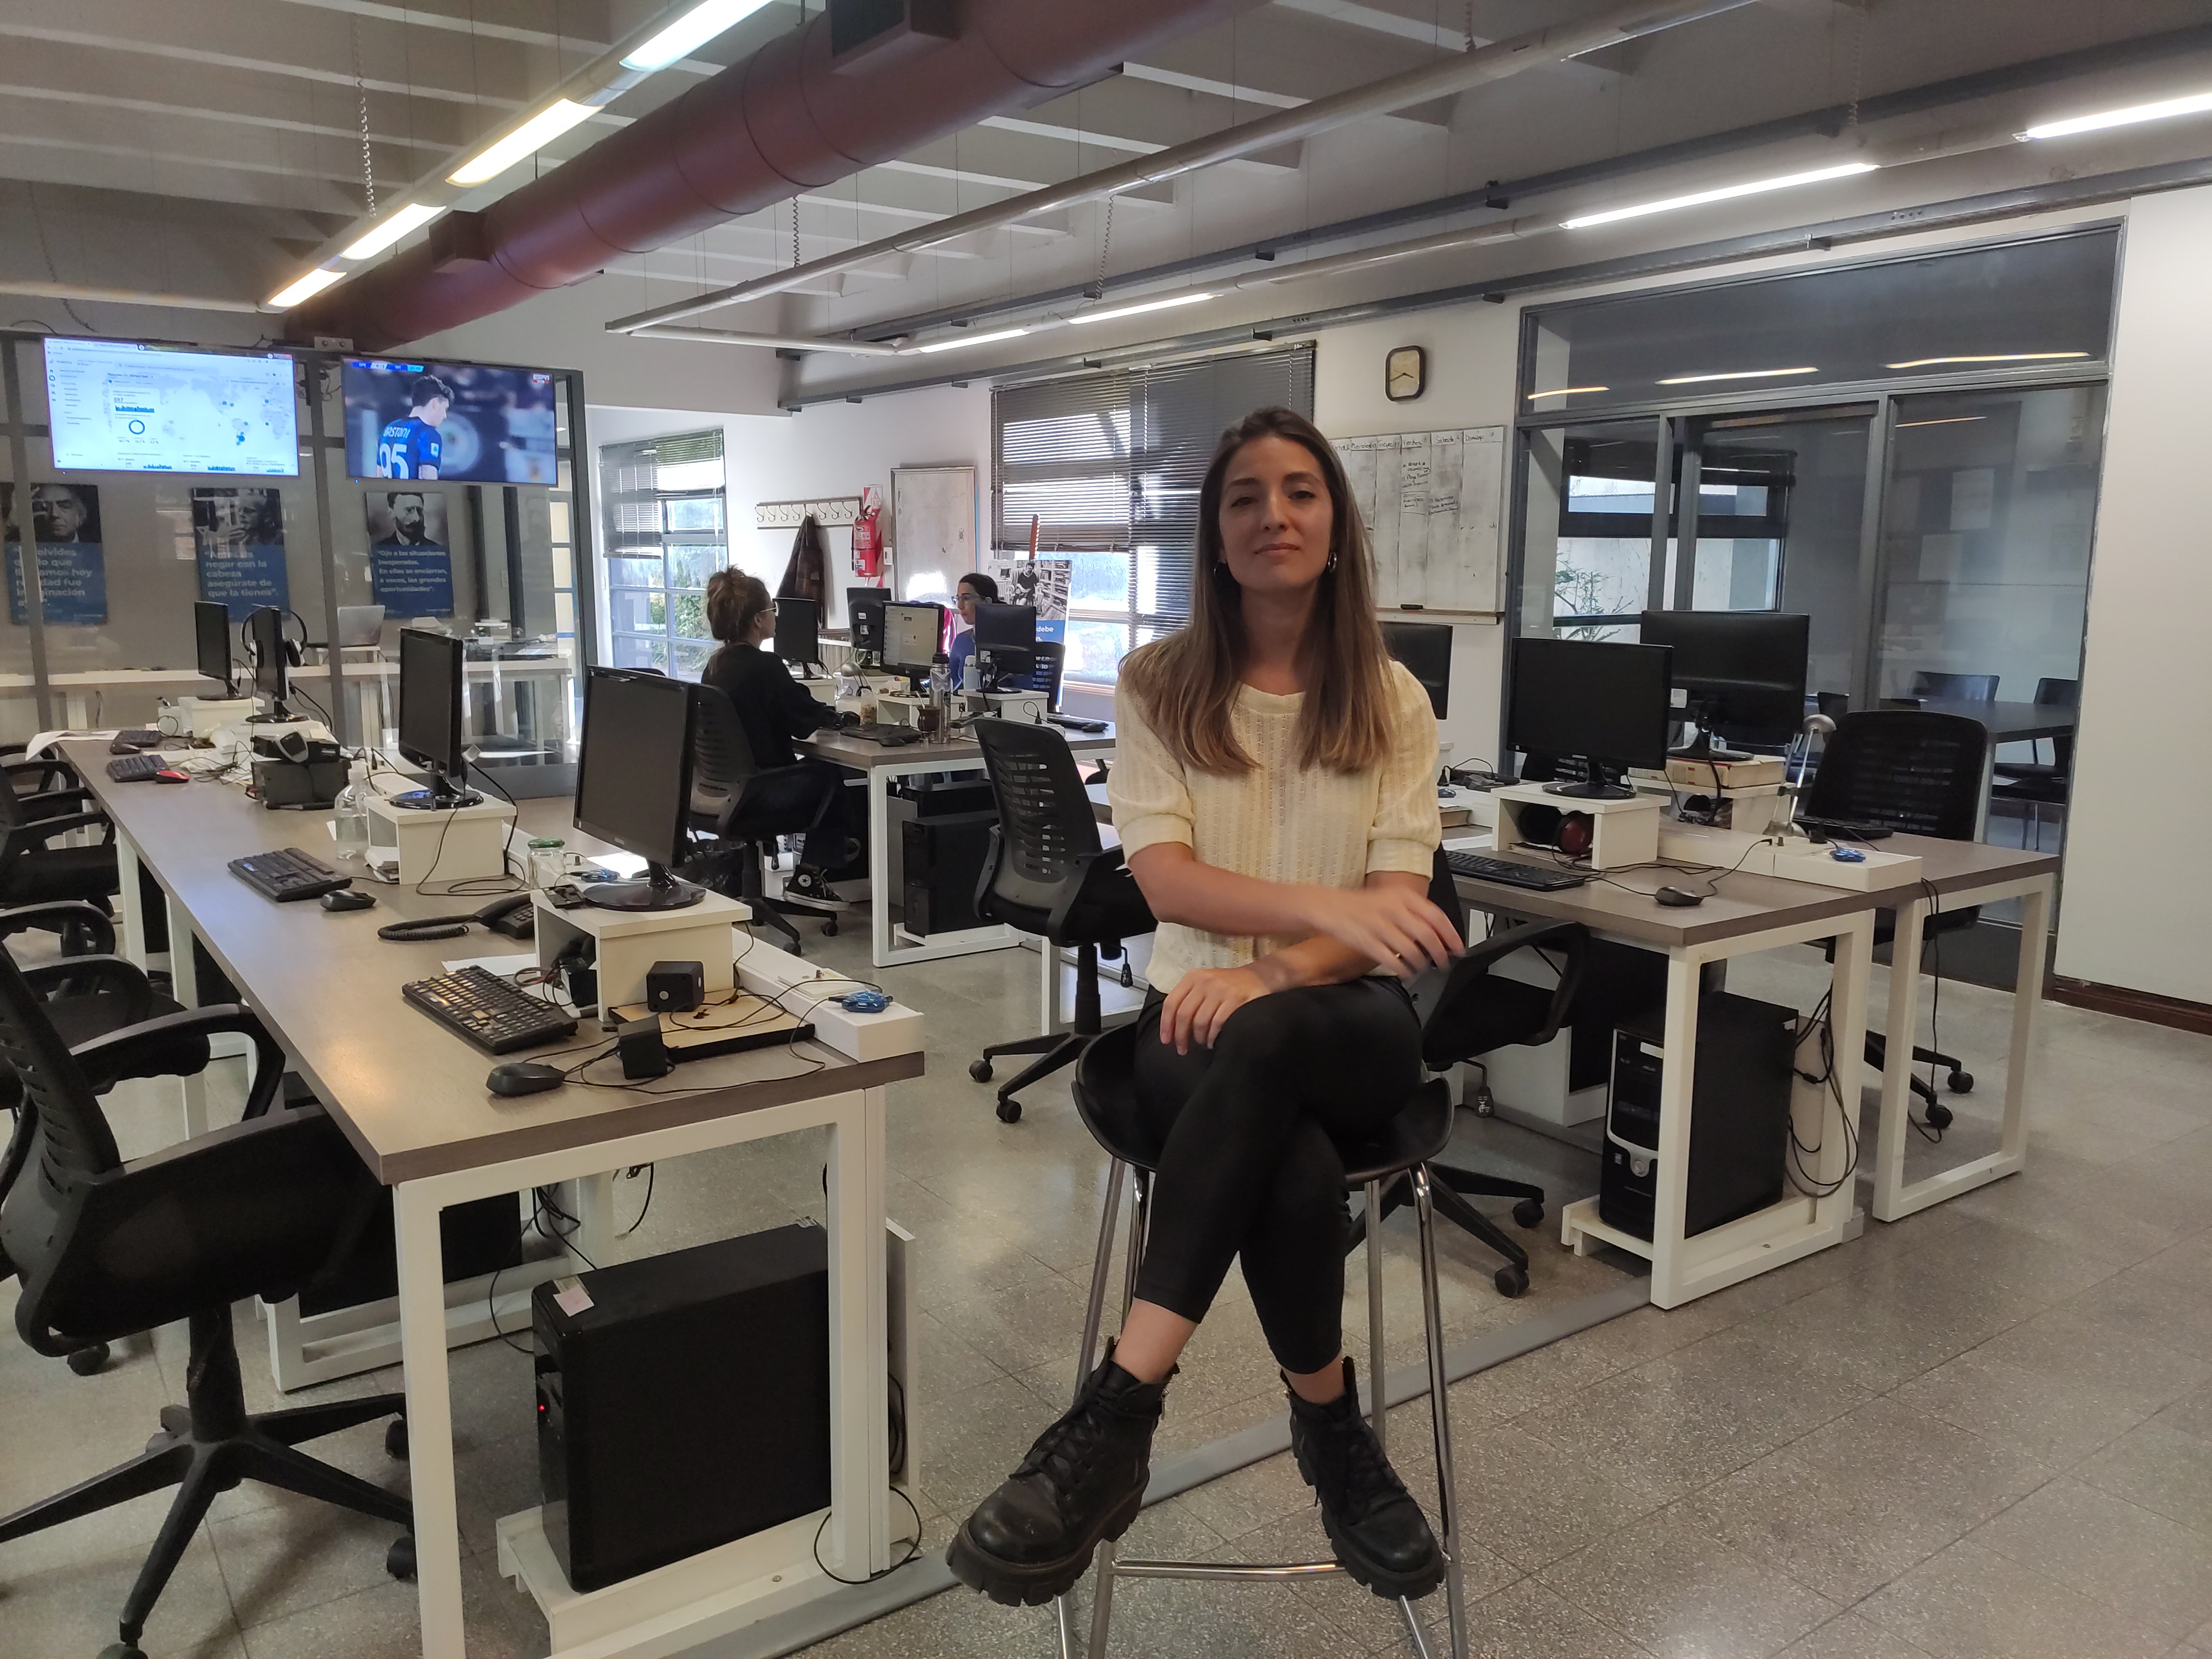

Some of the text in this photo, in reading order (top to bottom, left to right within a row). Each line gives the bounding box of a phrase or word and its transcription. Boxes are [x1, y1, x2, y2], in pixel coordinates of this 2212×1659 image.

[379, 443, 409, 479] 95
[258, 560, 268, 568] la
[259, 578, 272, 587] de
